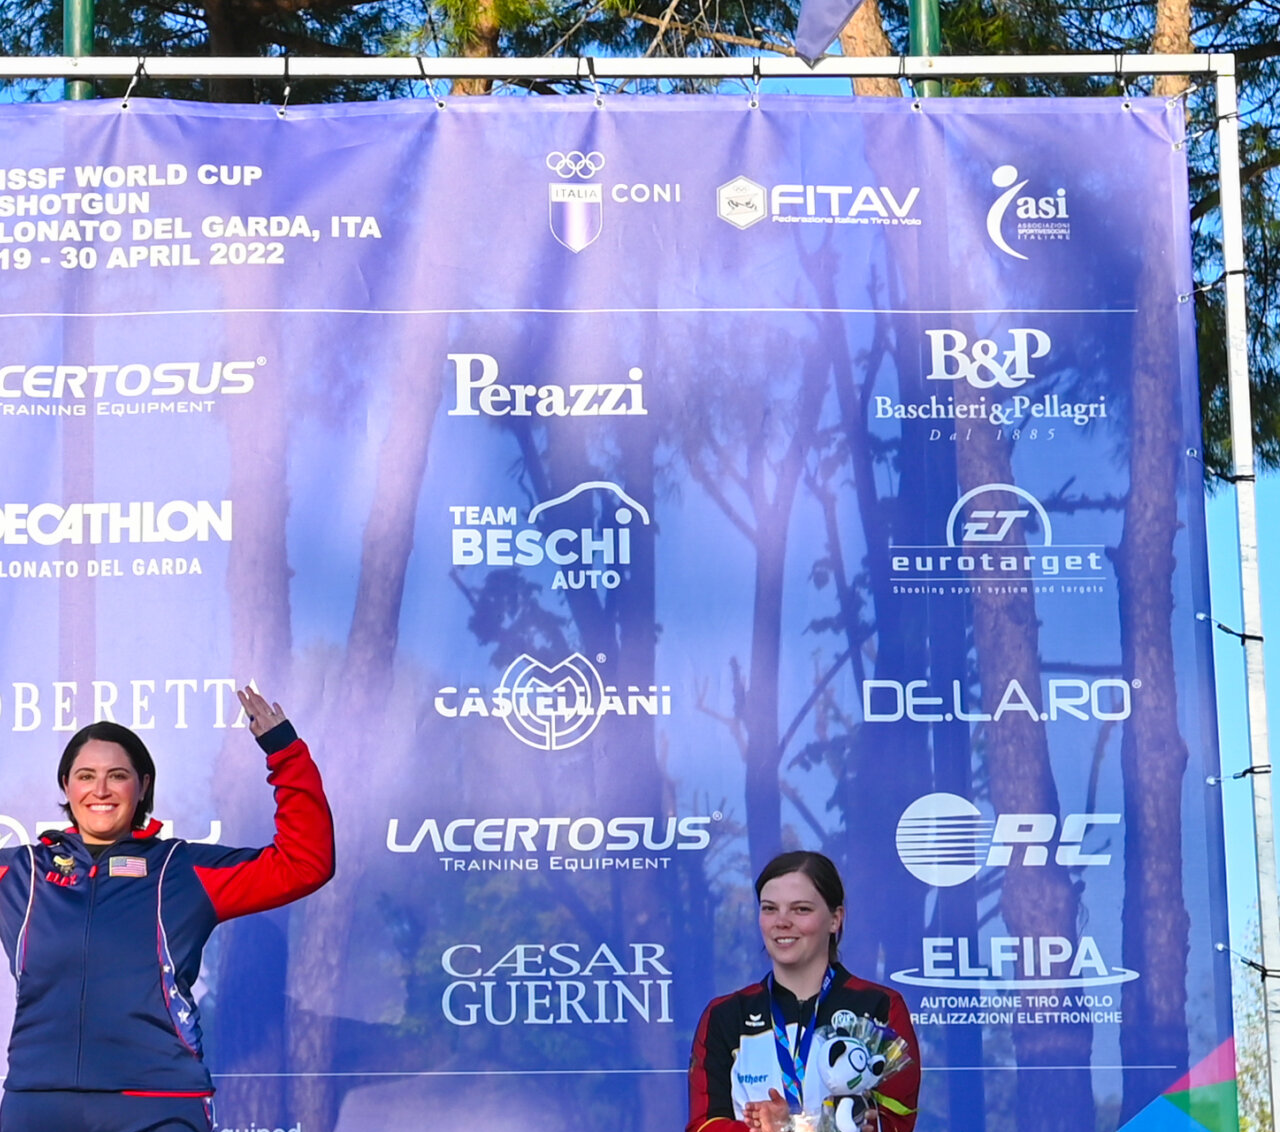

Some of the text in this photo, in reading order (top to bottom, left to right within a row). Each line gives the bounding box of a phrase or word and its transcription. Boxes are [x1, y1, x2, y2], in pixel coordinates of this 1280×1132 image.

[75, 164, 189, 188] WORLD
[198, 165, 262, 186] CUP
[556, 189, 597, 198] ITALIA
[612, 184, 680, 202] CONI
[771, 185, 920, 217] FITAV
[1016, 187, 1069, 219] asi
[132, 217, 192, 240] DEL
[201, 215, 321, 241] GARDA,
[329, 215, 382, 239] ITA
[58, 245, 98, 269] 30
[106, 244, 202, 269] APRIL
[209, 242, 284, 266] 2022
[925, 328, 1051, 388] B&P
[448, 352, 648, 416] Perazzi
[929, 429, 1055, 441] Dal 1885
[449, 506, 518, 526] TEAM
[963, 510, 1029, 541] ET
[86, 559, 124, 577] DEL
[132, 557, 203, 576] GARDA
[892, 553, 1102, 575] eurotarget
[552, 571, 621, 590] AUTO
[893, 586, 944, 595] Shooting
[951, 586, 982, 594] sport
[988, 586, 1028, 595] system
[1061, 585, 1103, 594] targets
[435, 685, 671, 717] CASTELLANI
[864, 679, 1131, 723] DE.LA.RO
[386, 816, 711, 855] LACERTOSUS
[922, 937, 1108, 977] ELFIPA
[442, 981, 673, 1026] GUERINI
[920, 996, 1113, 1009] AUTOMAZIONE TIRO A VOLO
[911, 1012, 1123, 1025] REALIZZAZIONI ELETTRONICHE
